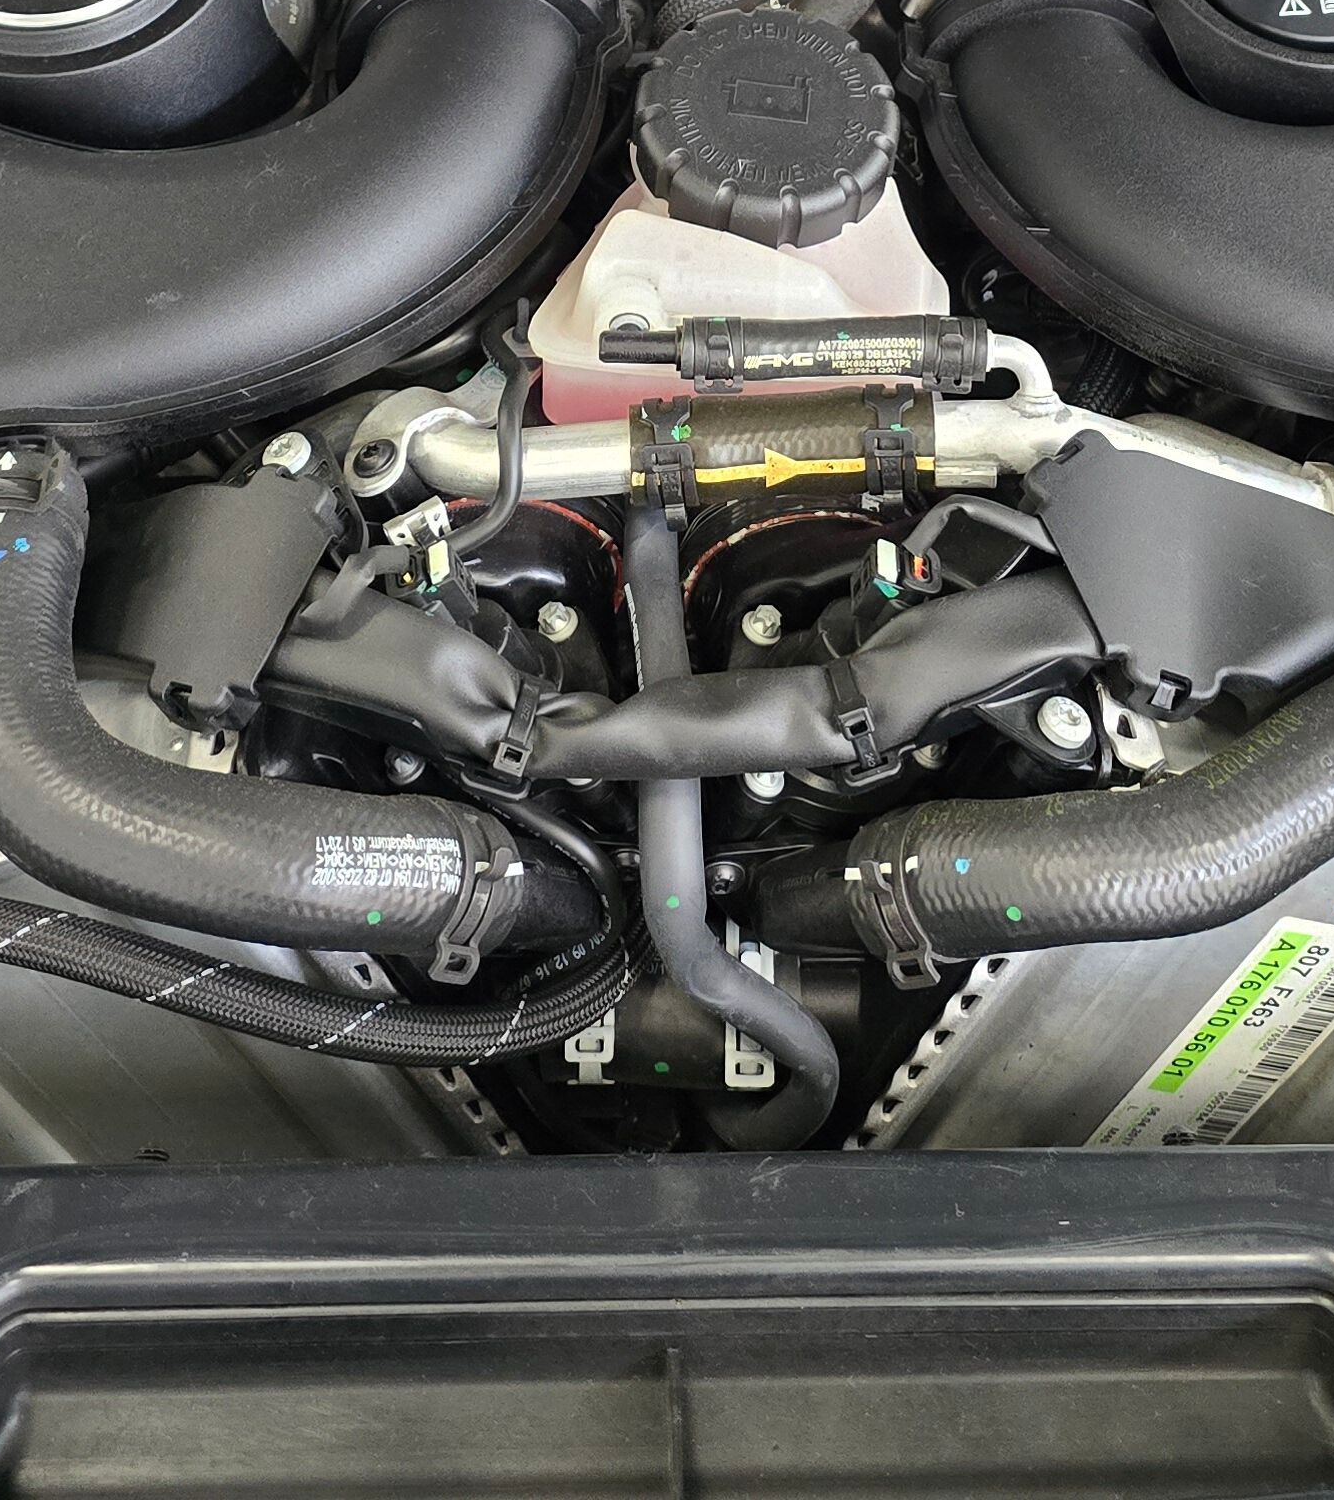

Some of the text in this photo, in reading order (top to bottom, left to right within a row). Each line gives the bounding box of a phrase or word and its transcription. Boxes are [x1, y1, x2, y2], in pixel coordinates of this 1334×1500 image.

[737, 22, 790, 41] OPEN
[839, 67, 868, 100] HOT
[413, 871, 428, 888] 177
[1162, 936, 1296, 1081] A 176 010 56 01
[1242, 943, 1330, 1031] 807 F463
